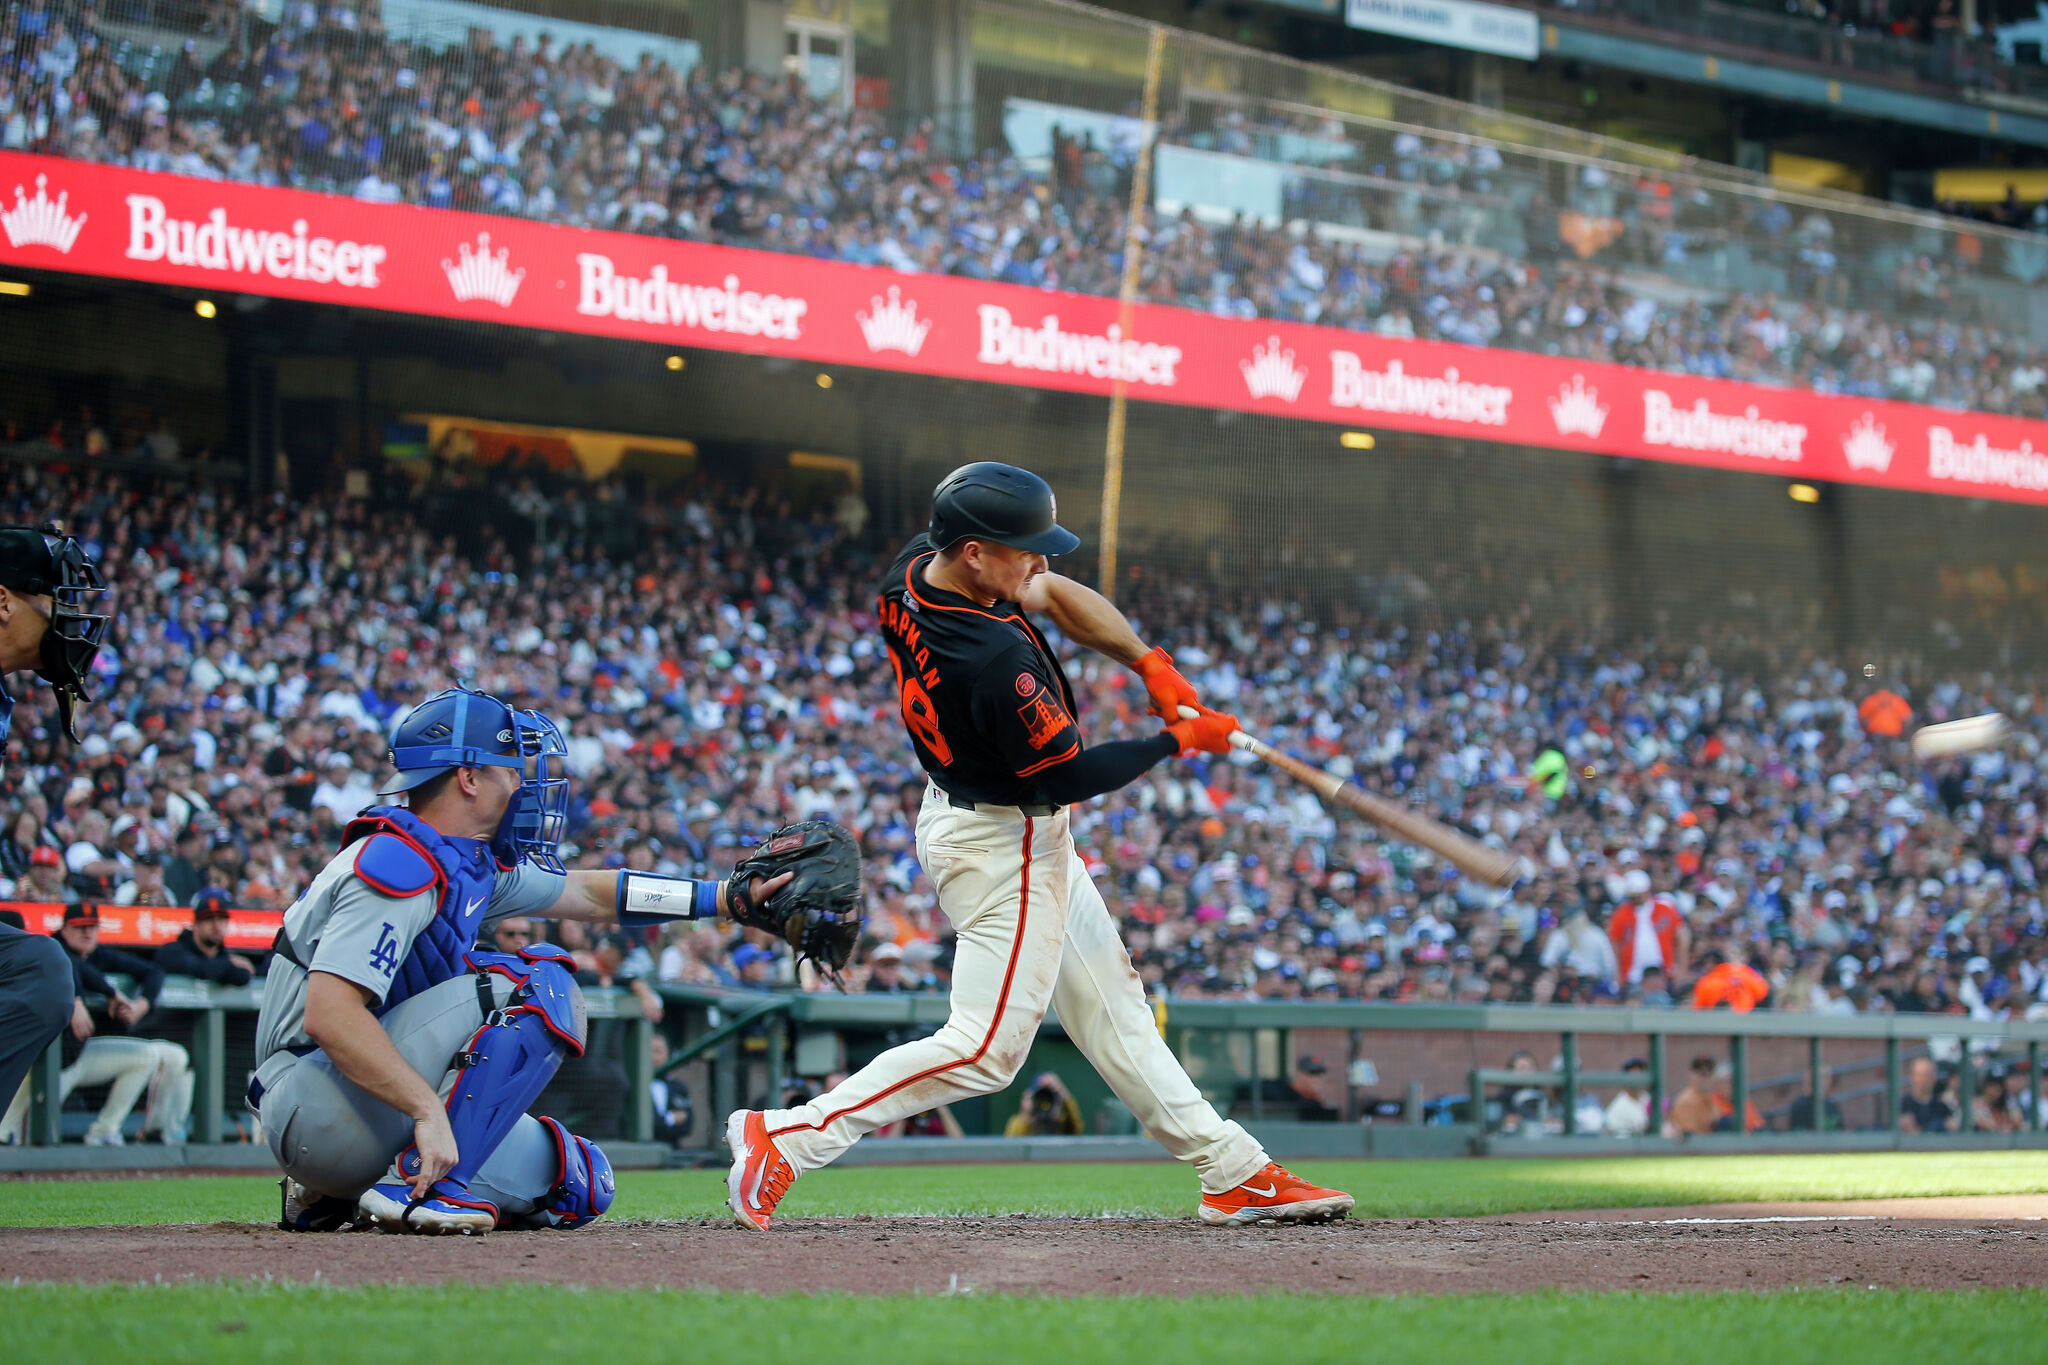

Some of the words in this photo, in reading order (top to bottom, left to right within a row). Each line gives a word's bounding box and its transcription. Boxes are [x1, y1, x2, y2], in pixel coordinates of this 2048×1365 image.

[126, 194, 387, 288] Budweiser
[577, 252, 808, 340] Budweiser
[977, 303, 1183, 387] Budweiser
[1330, 350, 1512, 426] Budweiser
[1642, 389, 1808, 462] Budweiser
[1927, 425, 2048, 491] Budweis
[1021, 679, 1034, 693] 30
[369, 921, 398, 979] LA
